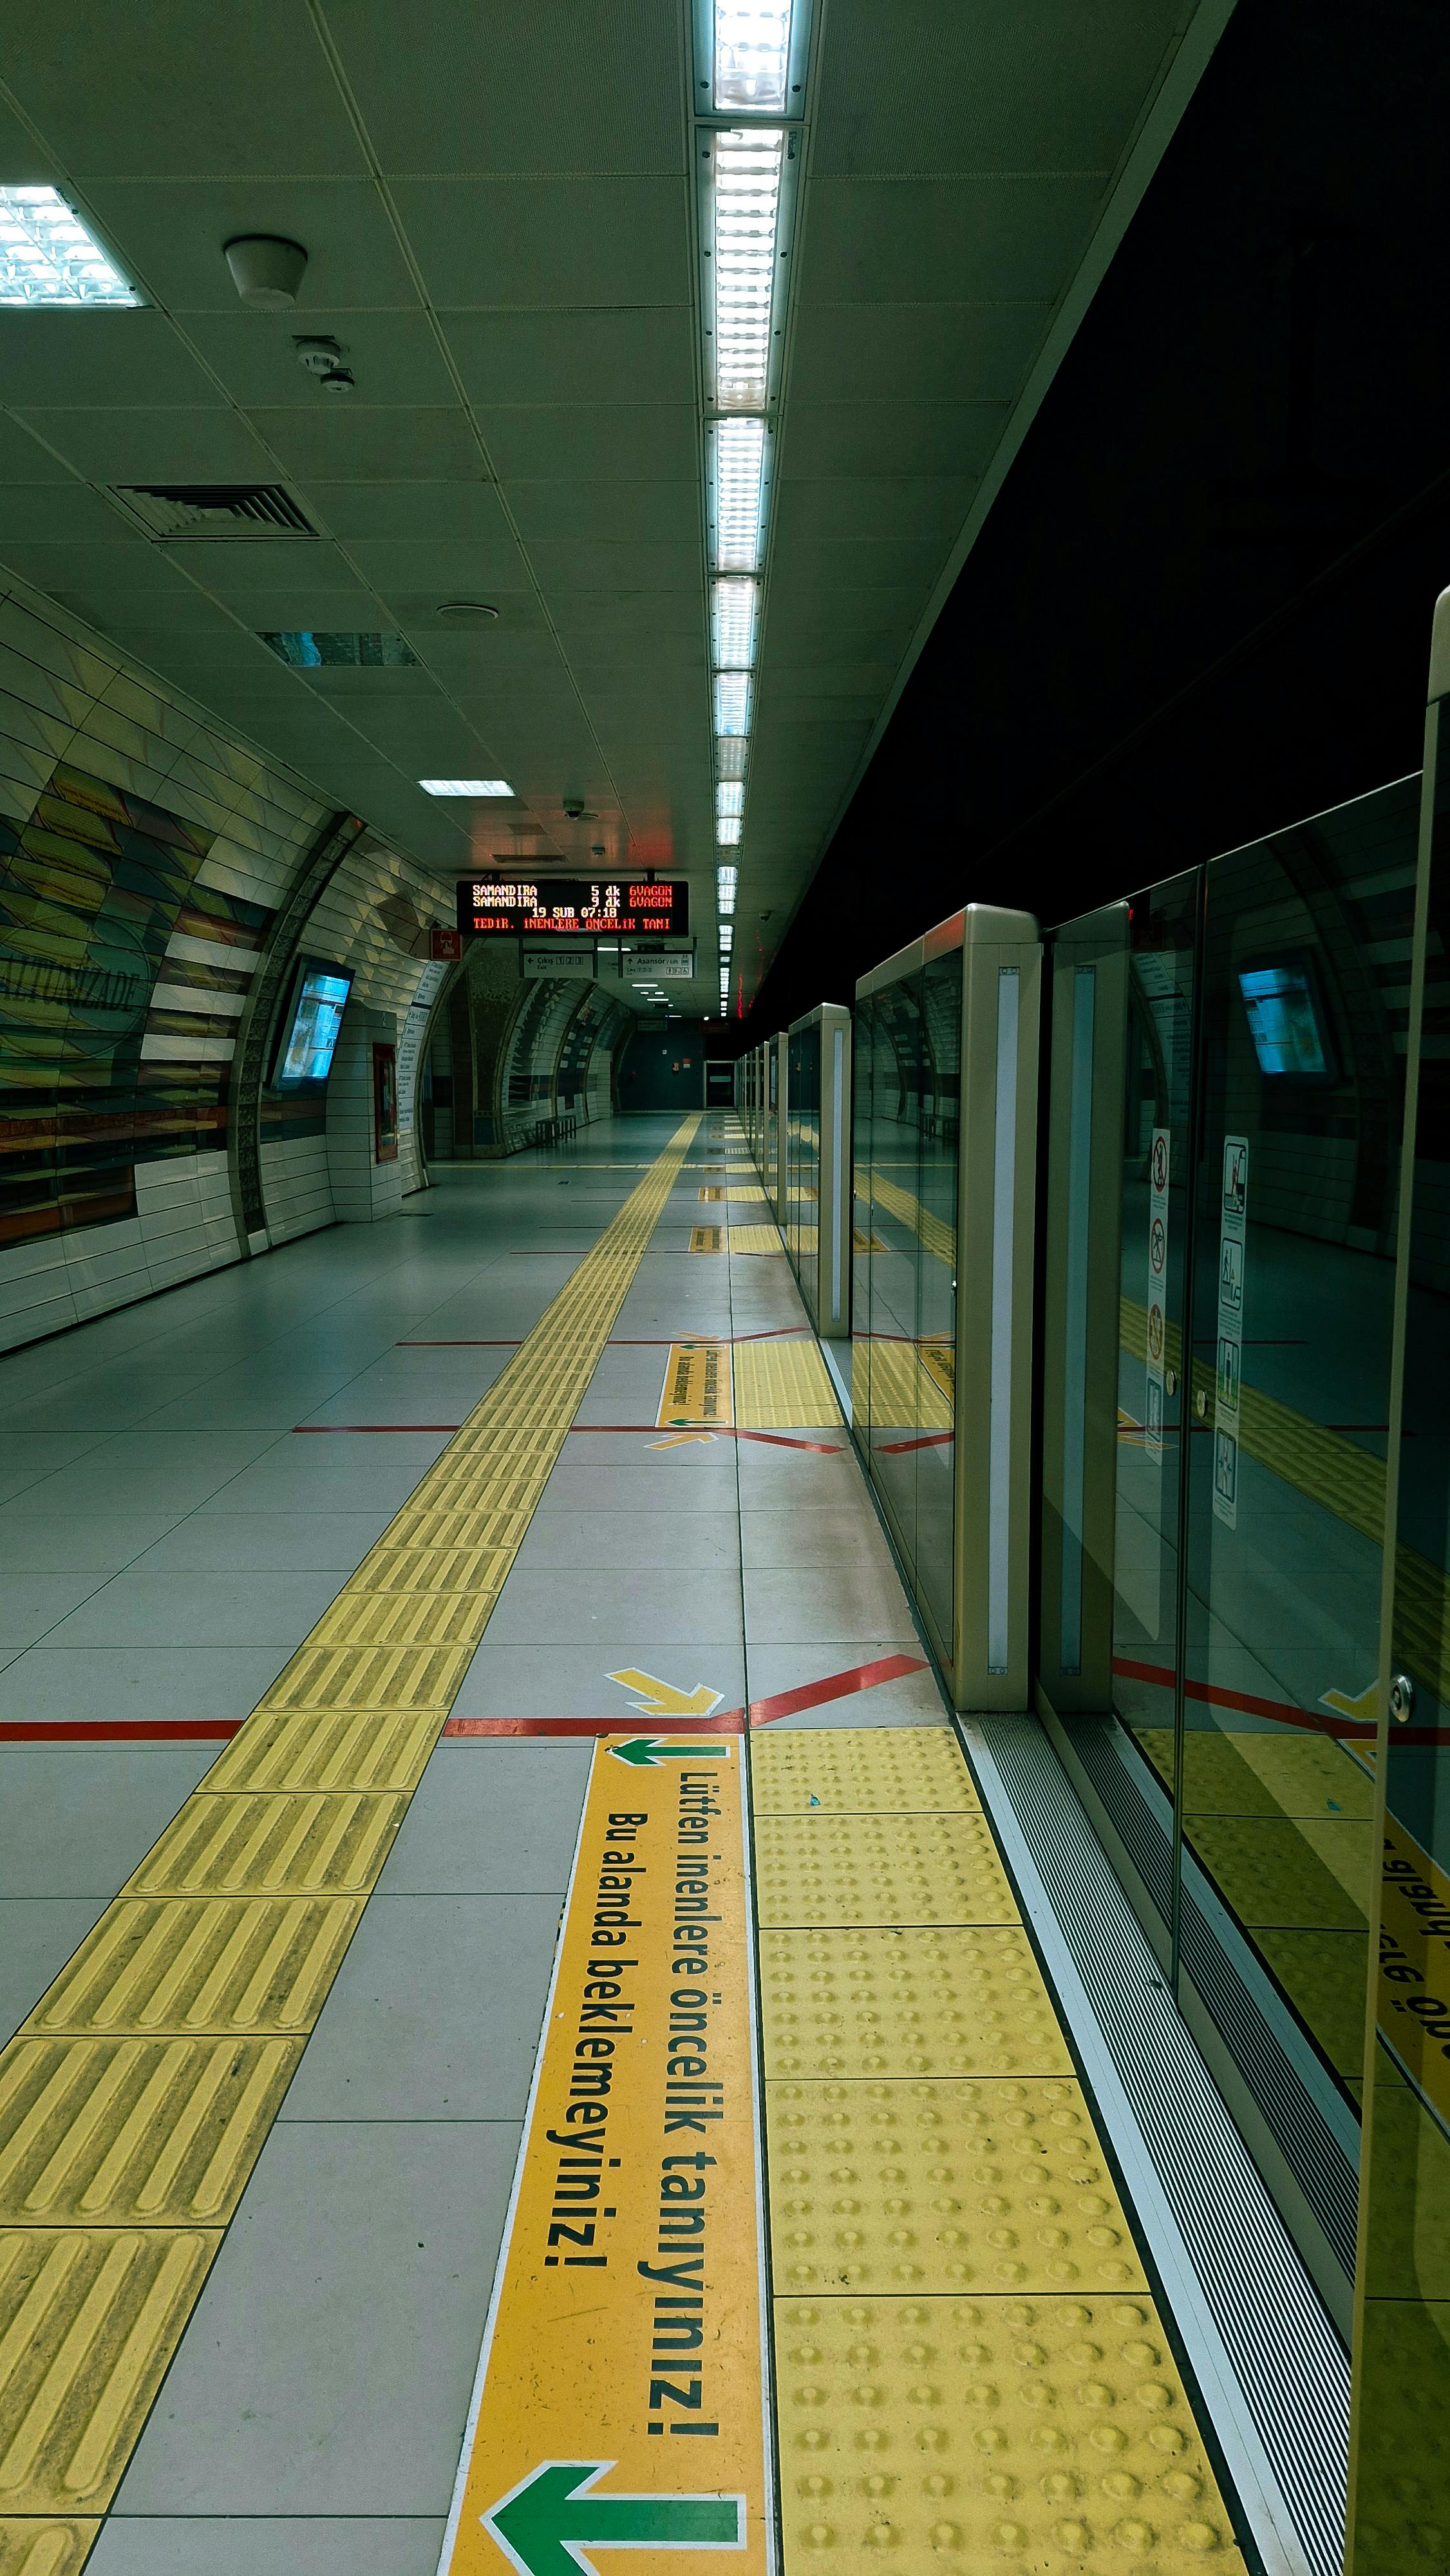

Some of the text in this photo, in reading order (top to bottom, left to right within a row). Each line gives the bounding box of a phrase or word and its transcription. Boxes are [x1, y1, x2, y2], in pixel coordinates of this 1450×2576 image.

[473, 885, 673, 896] SAMANDIRA 5 dk 6VAGON
[473, 896, 673, 907] SAMANDIRA 9 dk 6VAGON
[532, 907, 547, 918] 19
[581, 907, 617, 918] 07:18
[643, 918, 670, 929] TANI
[545, 1814, 648, 2266] Bu alanda beklemeyiniz!
[637, 1773, 723, 2436] Lütfen inenlere öncelik tanıyınız!
